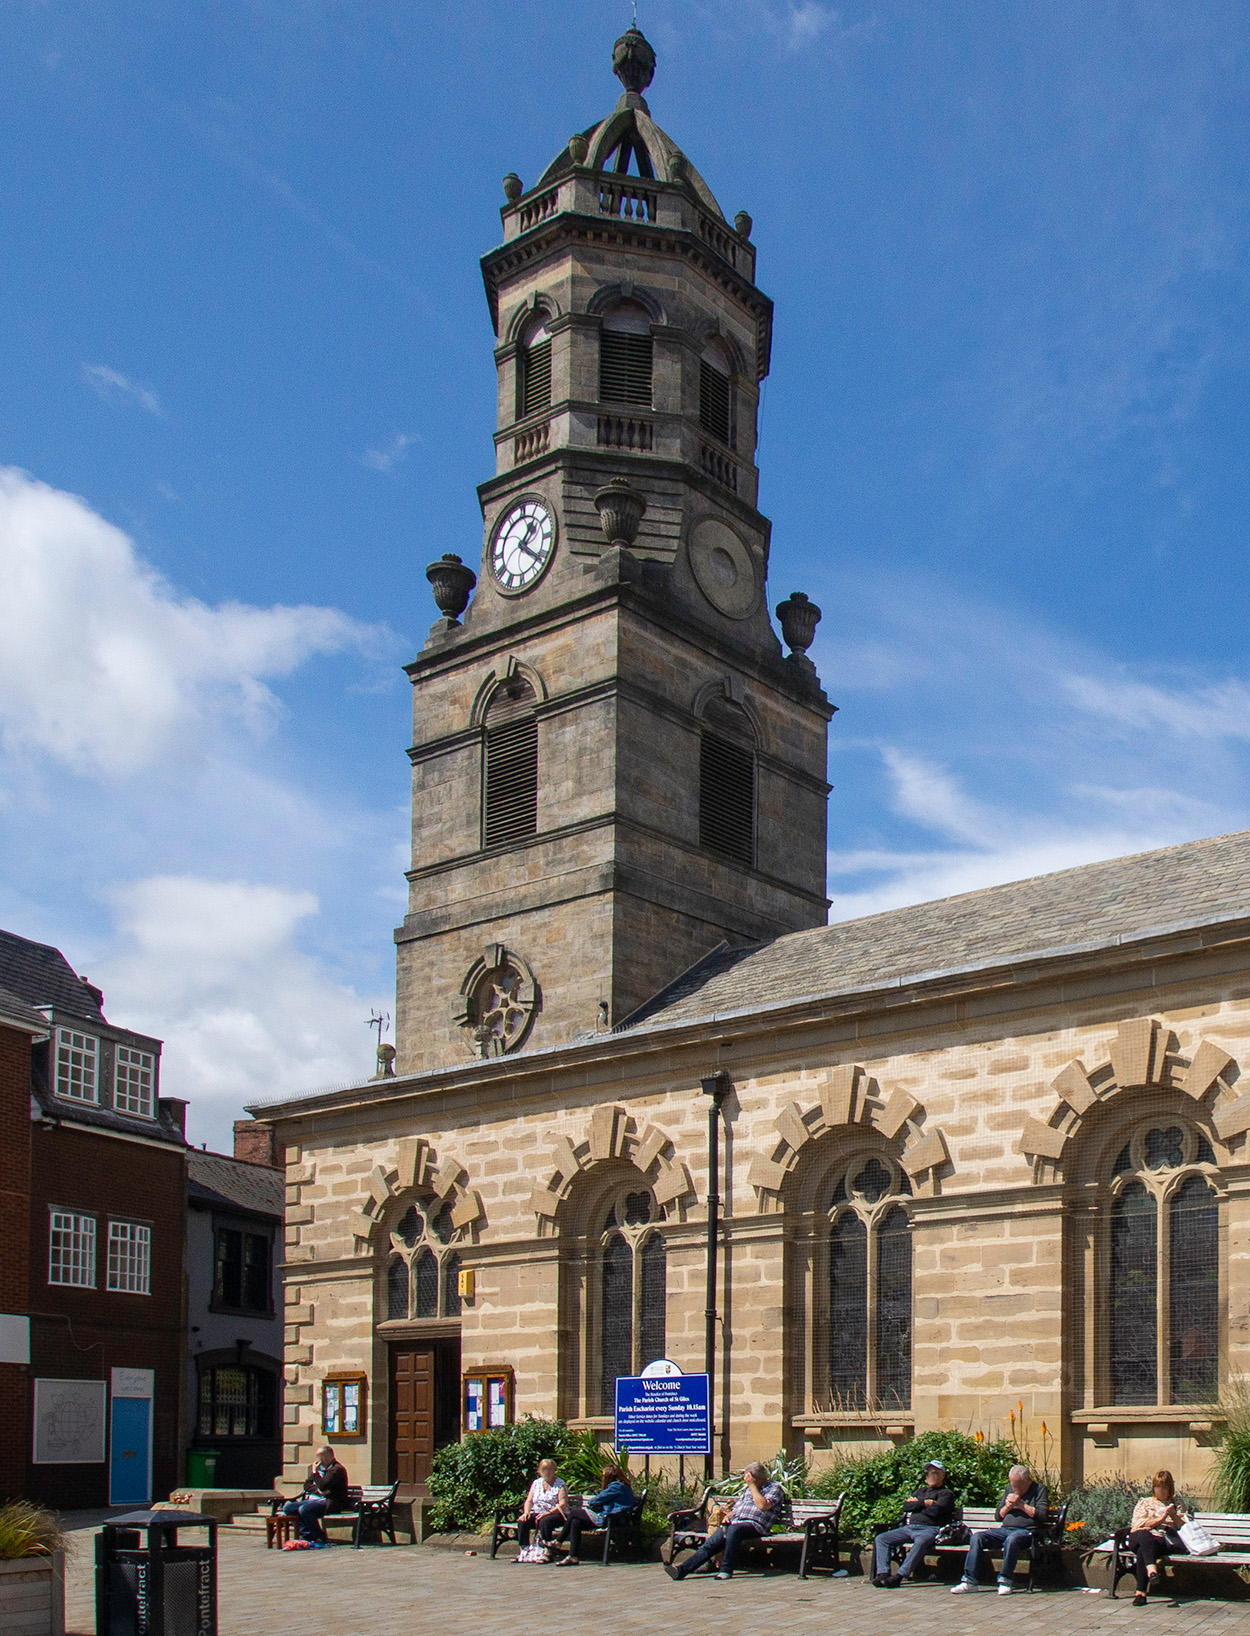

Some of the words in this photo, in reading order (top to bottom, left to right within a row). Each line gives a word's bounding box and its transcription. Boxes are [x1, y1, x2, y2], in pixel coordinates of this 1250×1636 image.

[642, 1381, 681, 1390] Welcome
[668, 1404, 685, 1412] Sunday
[136, 1563, 147, 1636] ontefract
